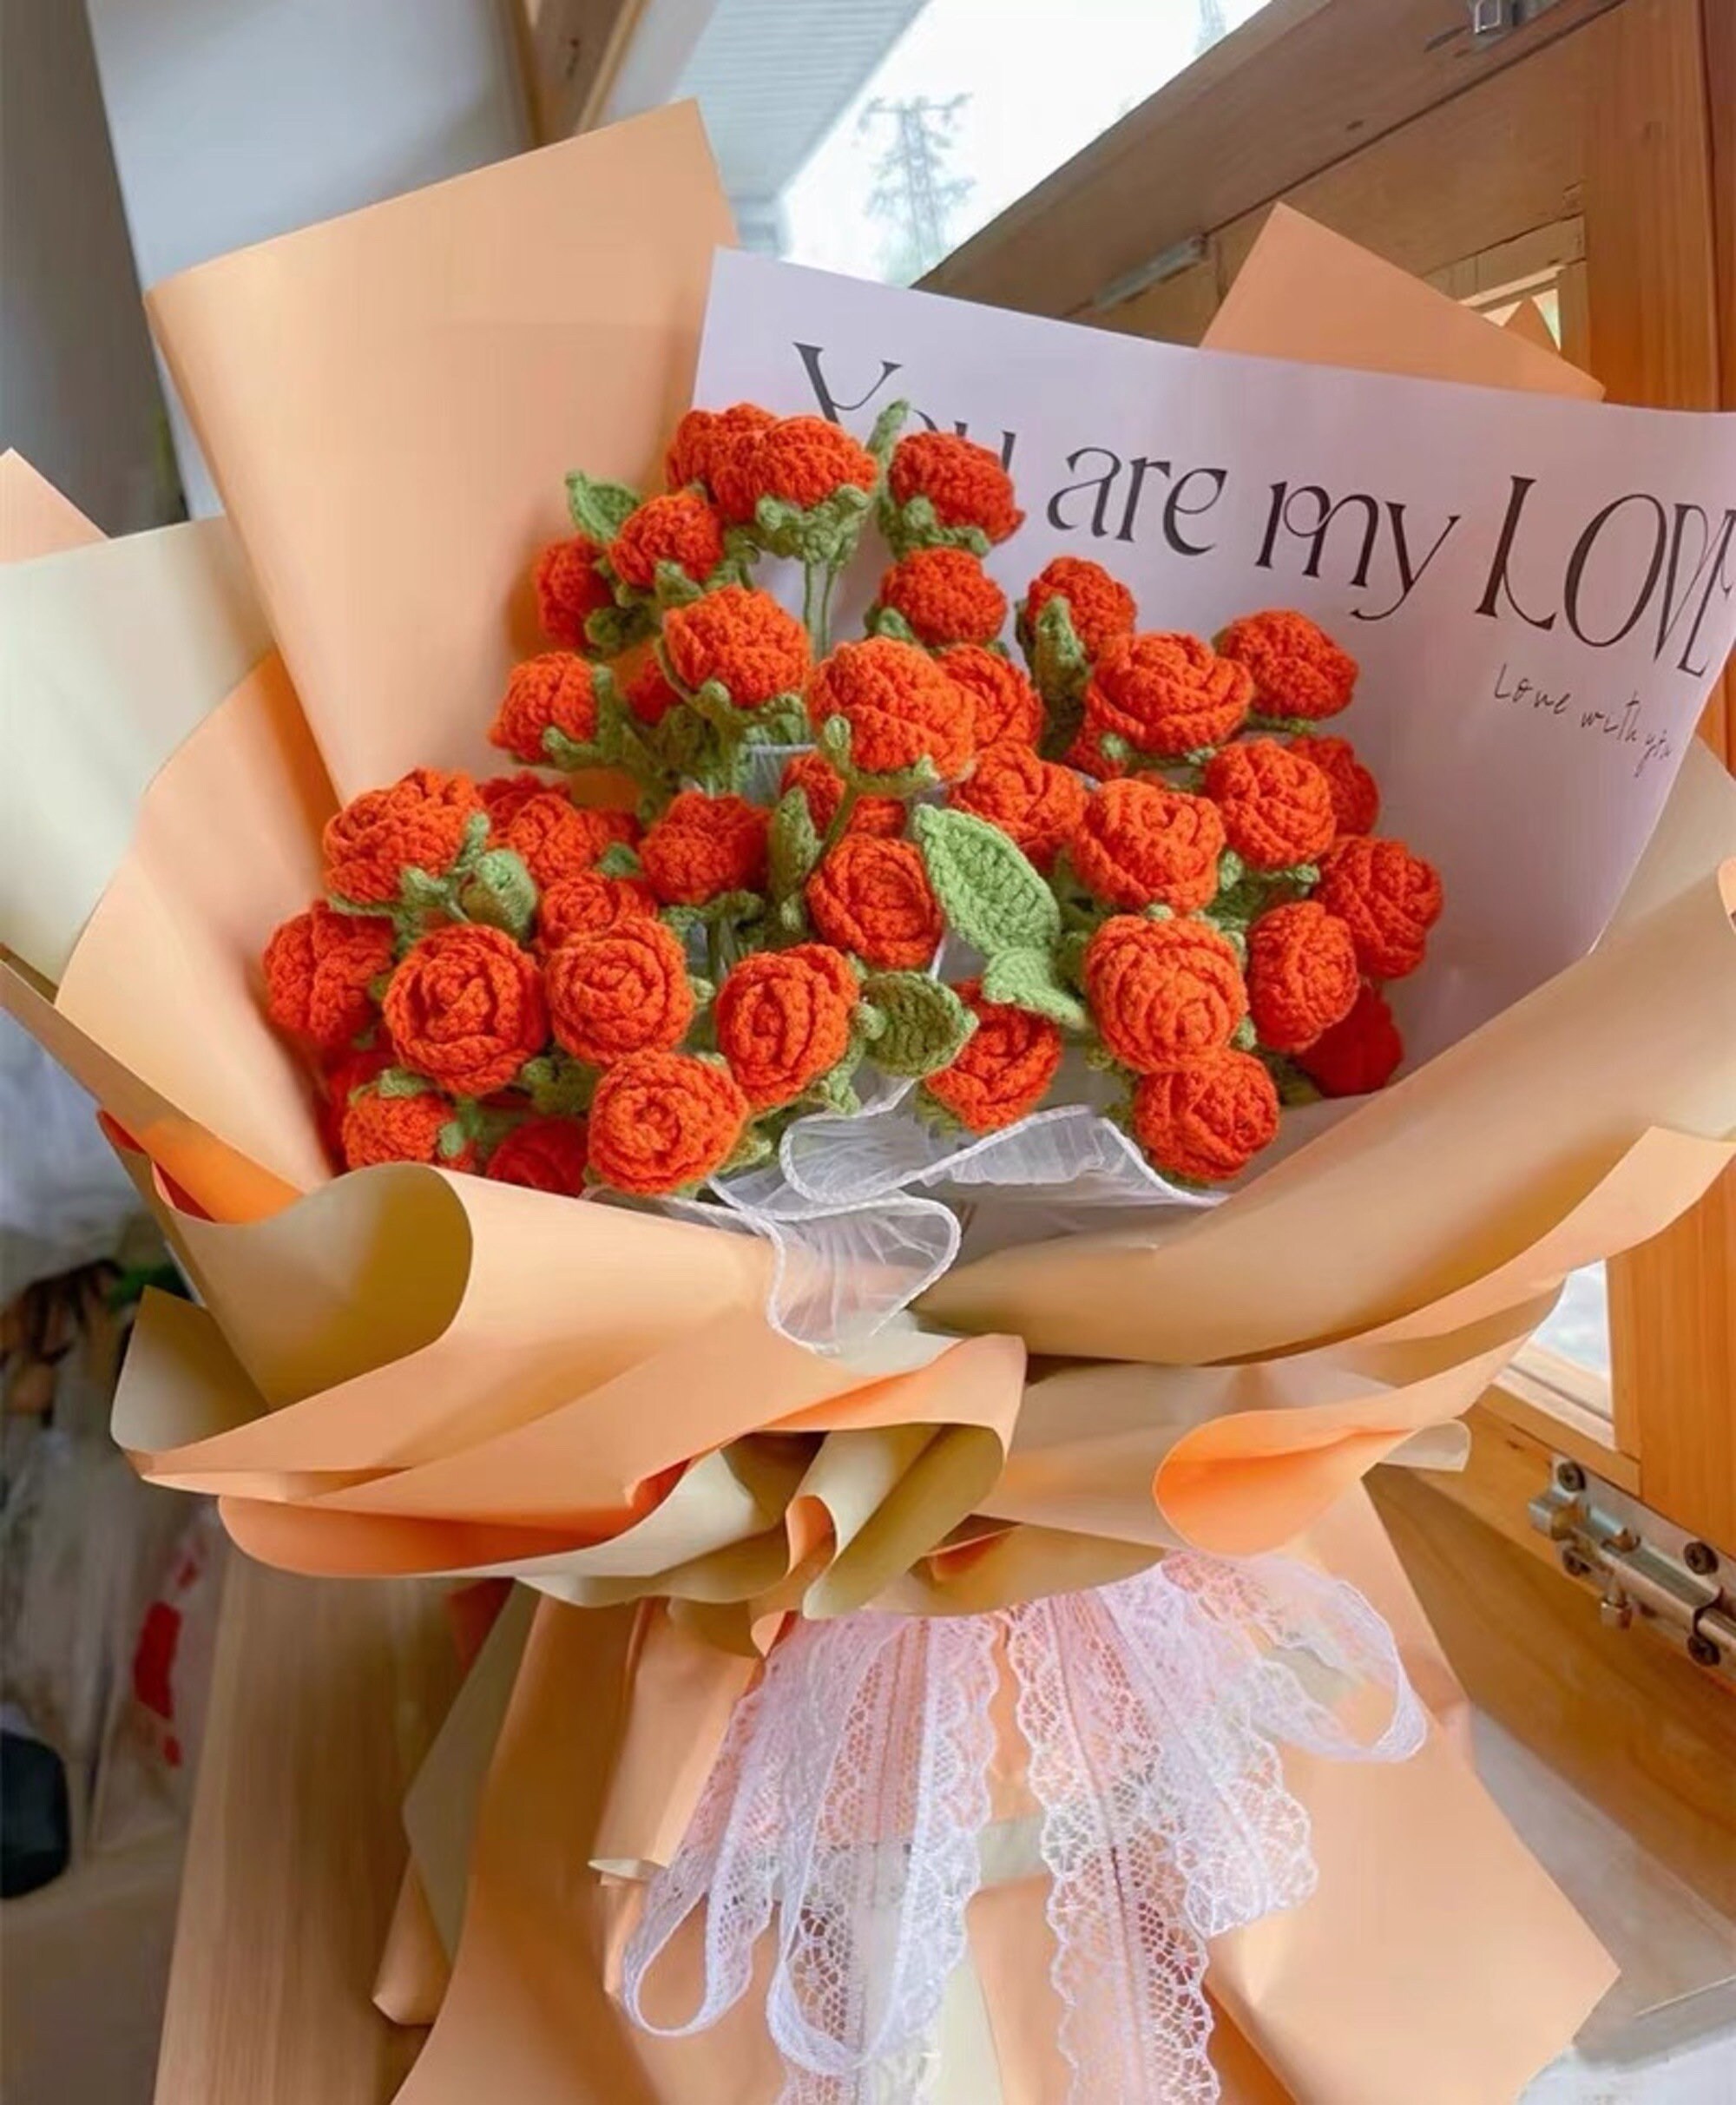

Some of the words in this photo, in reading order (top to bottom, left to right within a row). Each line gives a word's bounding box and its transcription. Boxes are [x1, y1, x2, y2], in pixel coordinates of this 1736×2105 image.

[1047, 446, 1228, 556] are
[1254, 481, 1462, 622] my
[1475, 474, 1736, 679] LOVE
[1581, 689, 1641, 741] with
